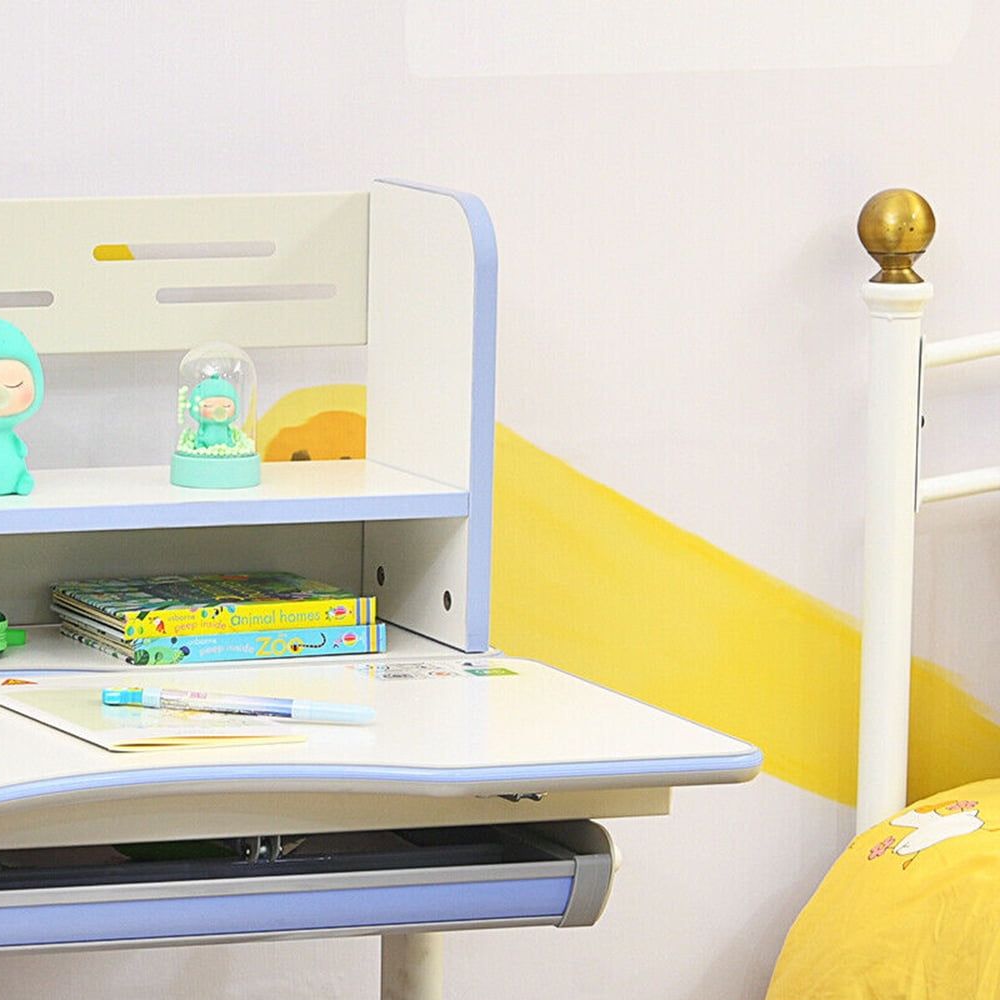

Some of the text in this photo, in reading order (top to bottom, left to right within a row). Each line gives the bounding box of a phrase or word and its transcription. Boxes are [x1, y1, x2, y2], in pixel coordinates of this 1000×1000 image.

[200, 619, 227, 630] inside
[230, 609, 321, 626] animal homes
